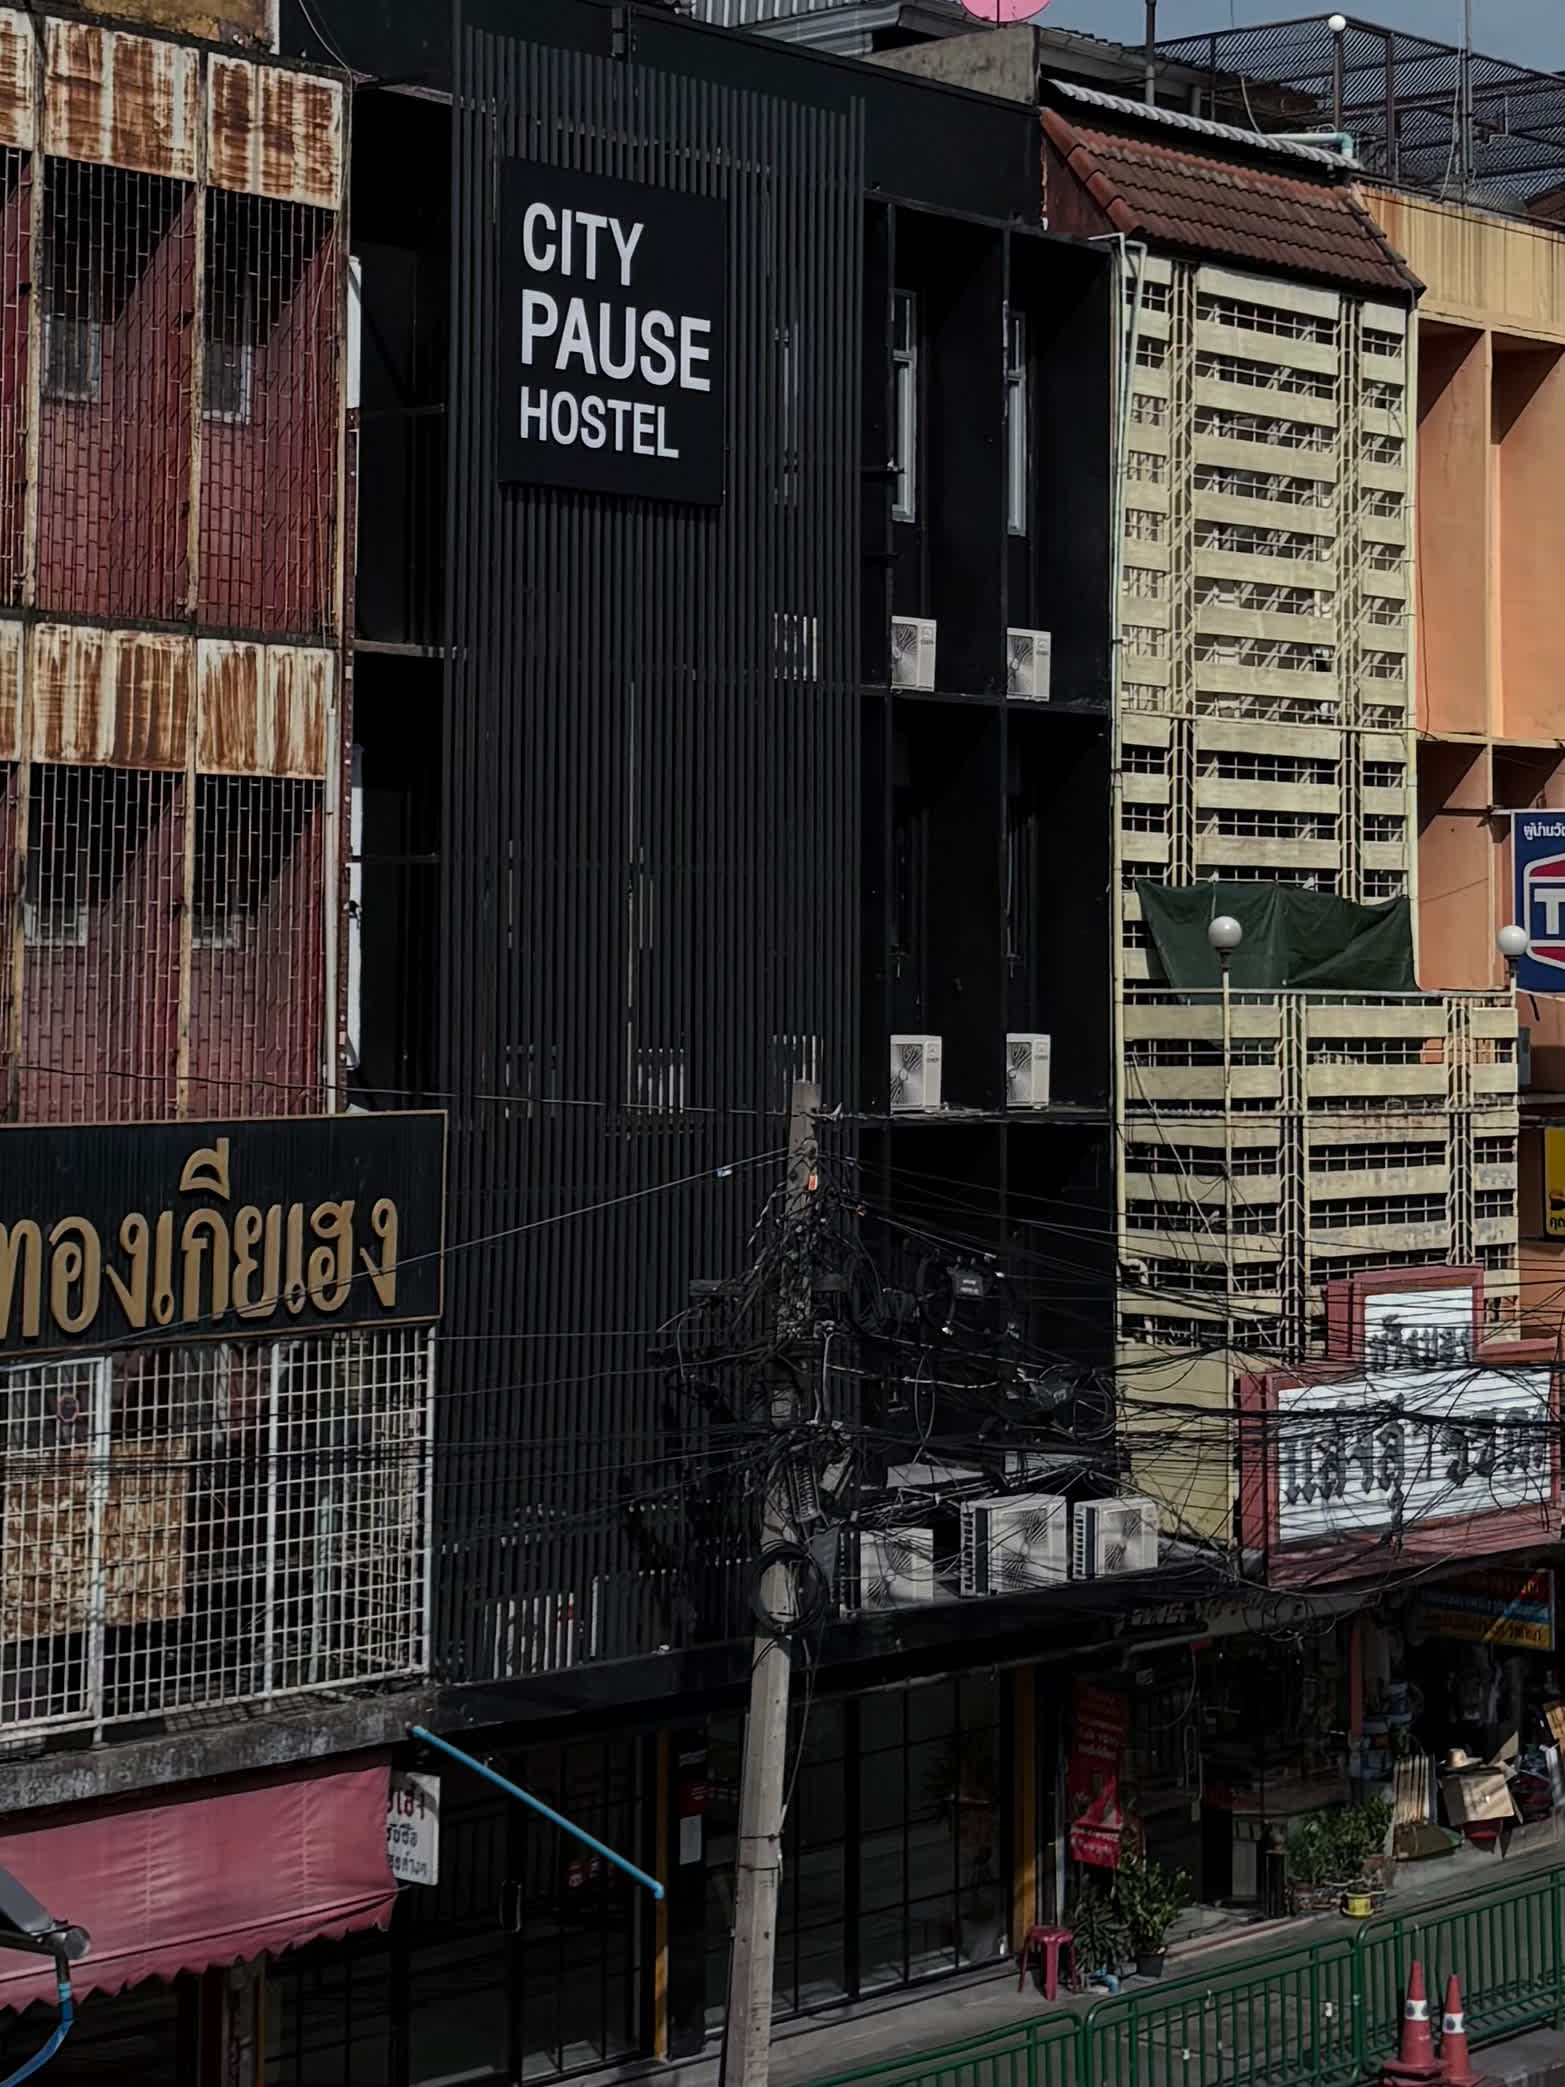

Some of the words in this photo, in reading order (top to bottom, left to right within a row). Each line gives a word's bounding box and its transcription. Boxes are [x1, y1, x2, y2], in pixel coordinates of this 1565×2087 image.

[522, 201, 645, 287] CITY
[520, 288, 712, 392] PAUSE
[519, 385, 680, 459] HOSTEL
